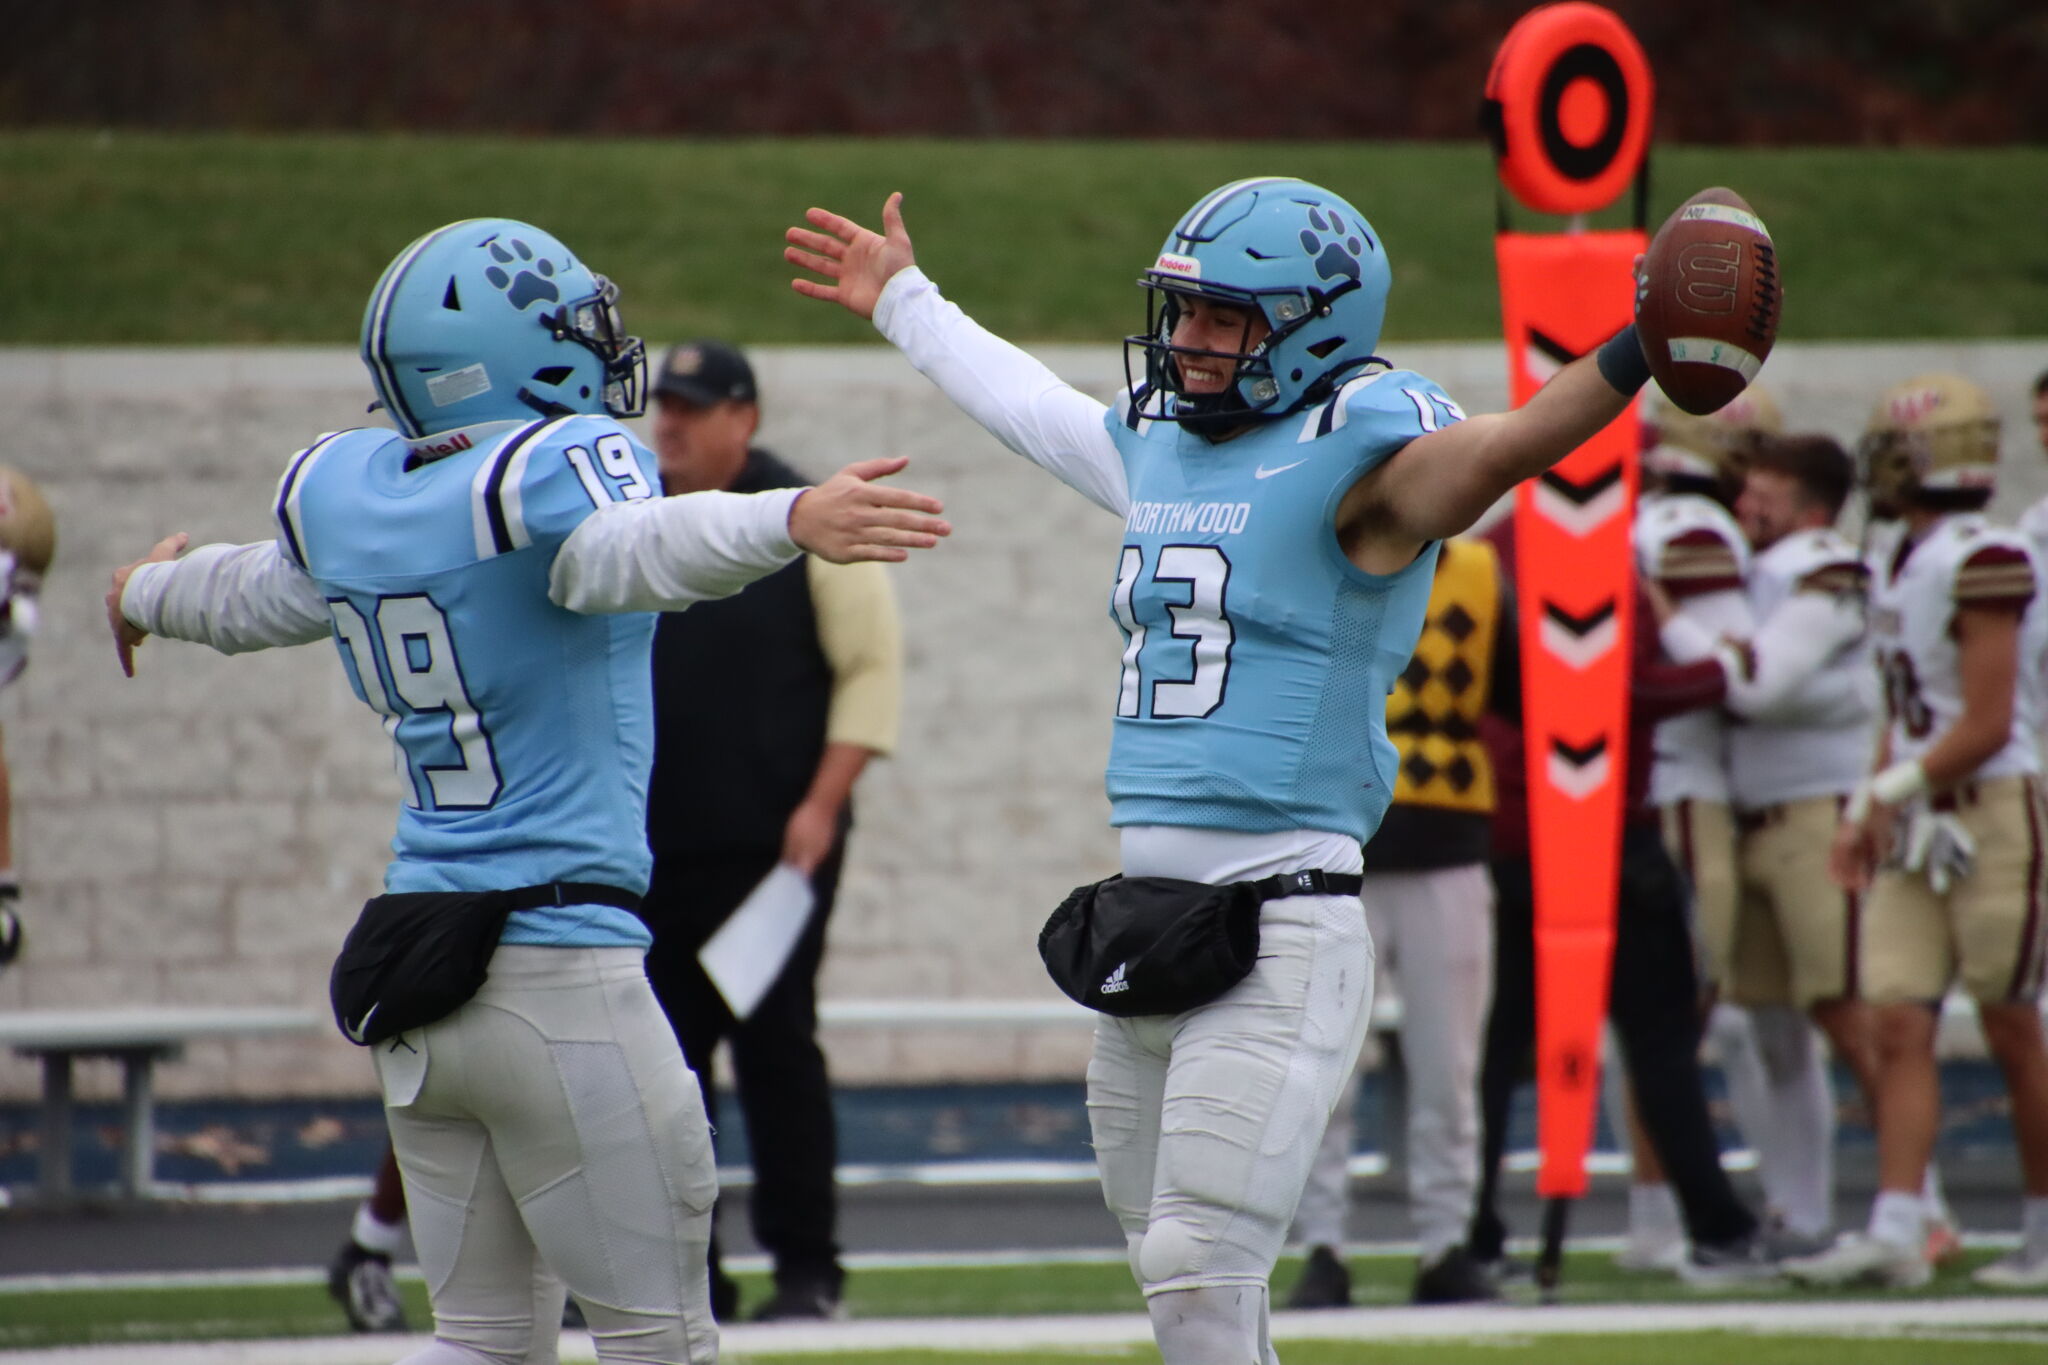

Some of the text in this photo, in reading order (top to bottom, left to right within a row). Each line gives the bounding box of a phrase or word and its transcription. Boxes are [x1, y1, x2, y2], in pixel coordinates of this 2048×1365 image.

[1540, 41, 1630, 184] 0
[563, 432, 653, 510] 19
[1126, 501, 1251, 535] NORTHWOOD
[1112, 543, 1236, 720] 13
[326, 591, 505, 812] 19
[1101, 980, 1129, 994] adidas
